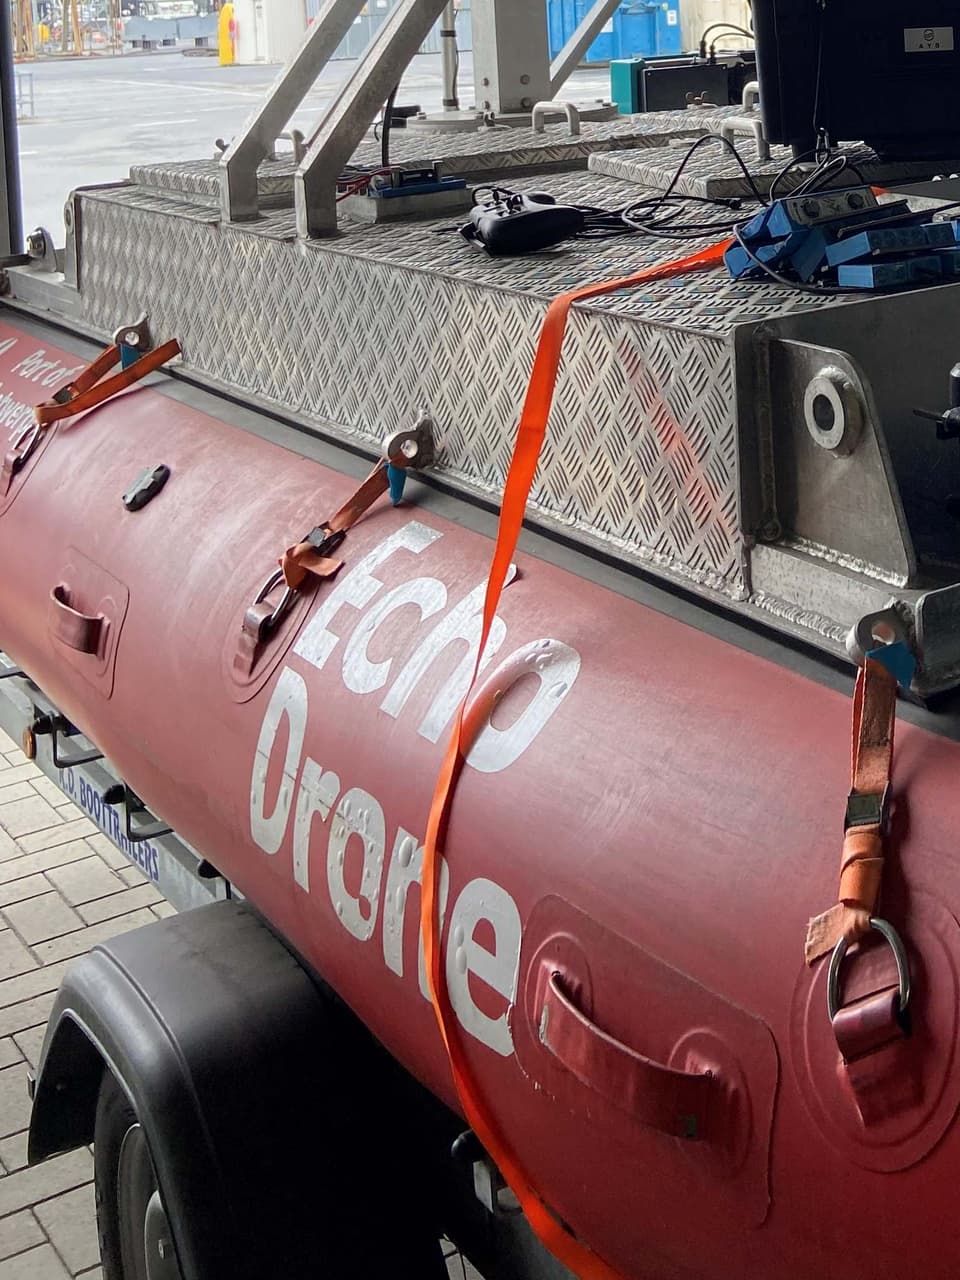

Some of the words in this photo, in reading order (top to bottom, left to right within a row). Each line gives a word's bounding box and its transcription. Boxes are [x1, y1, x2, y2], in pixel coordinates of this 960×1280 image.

[11, 349, 61, 382] Port
[41, 365, 85, 388] of
[293, 520, 581, 773] Echo
[250, 666, 522, 1057] Drone
